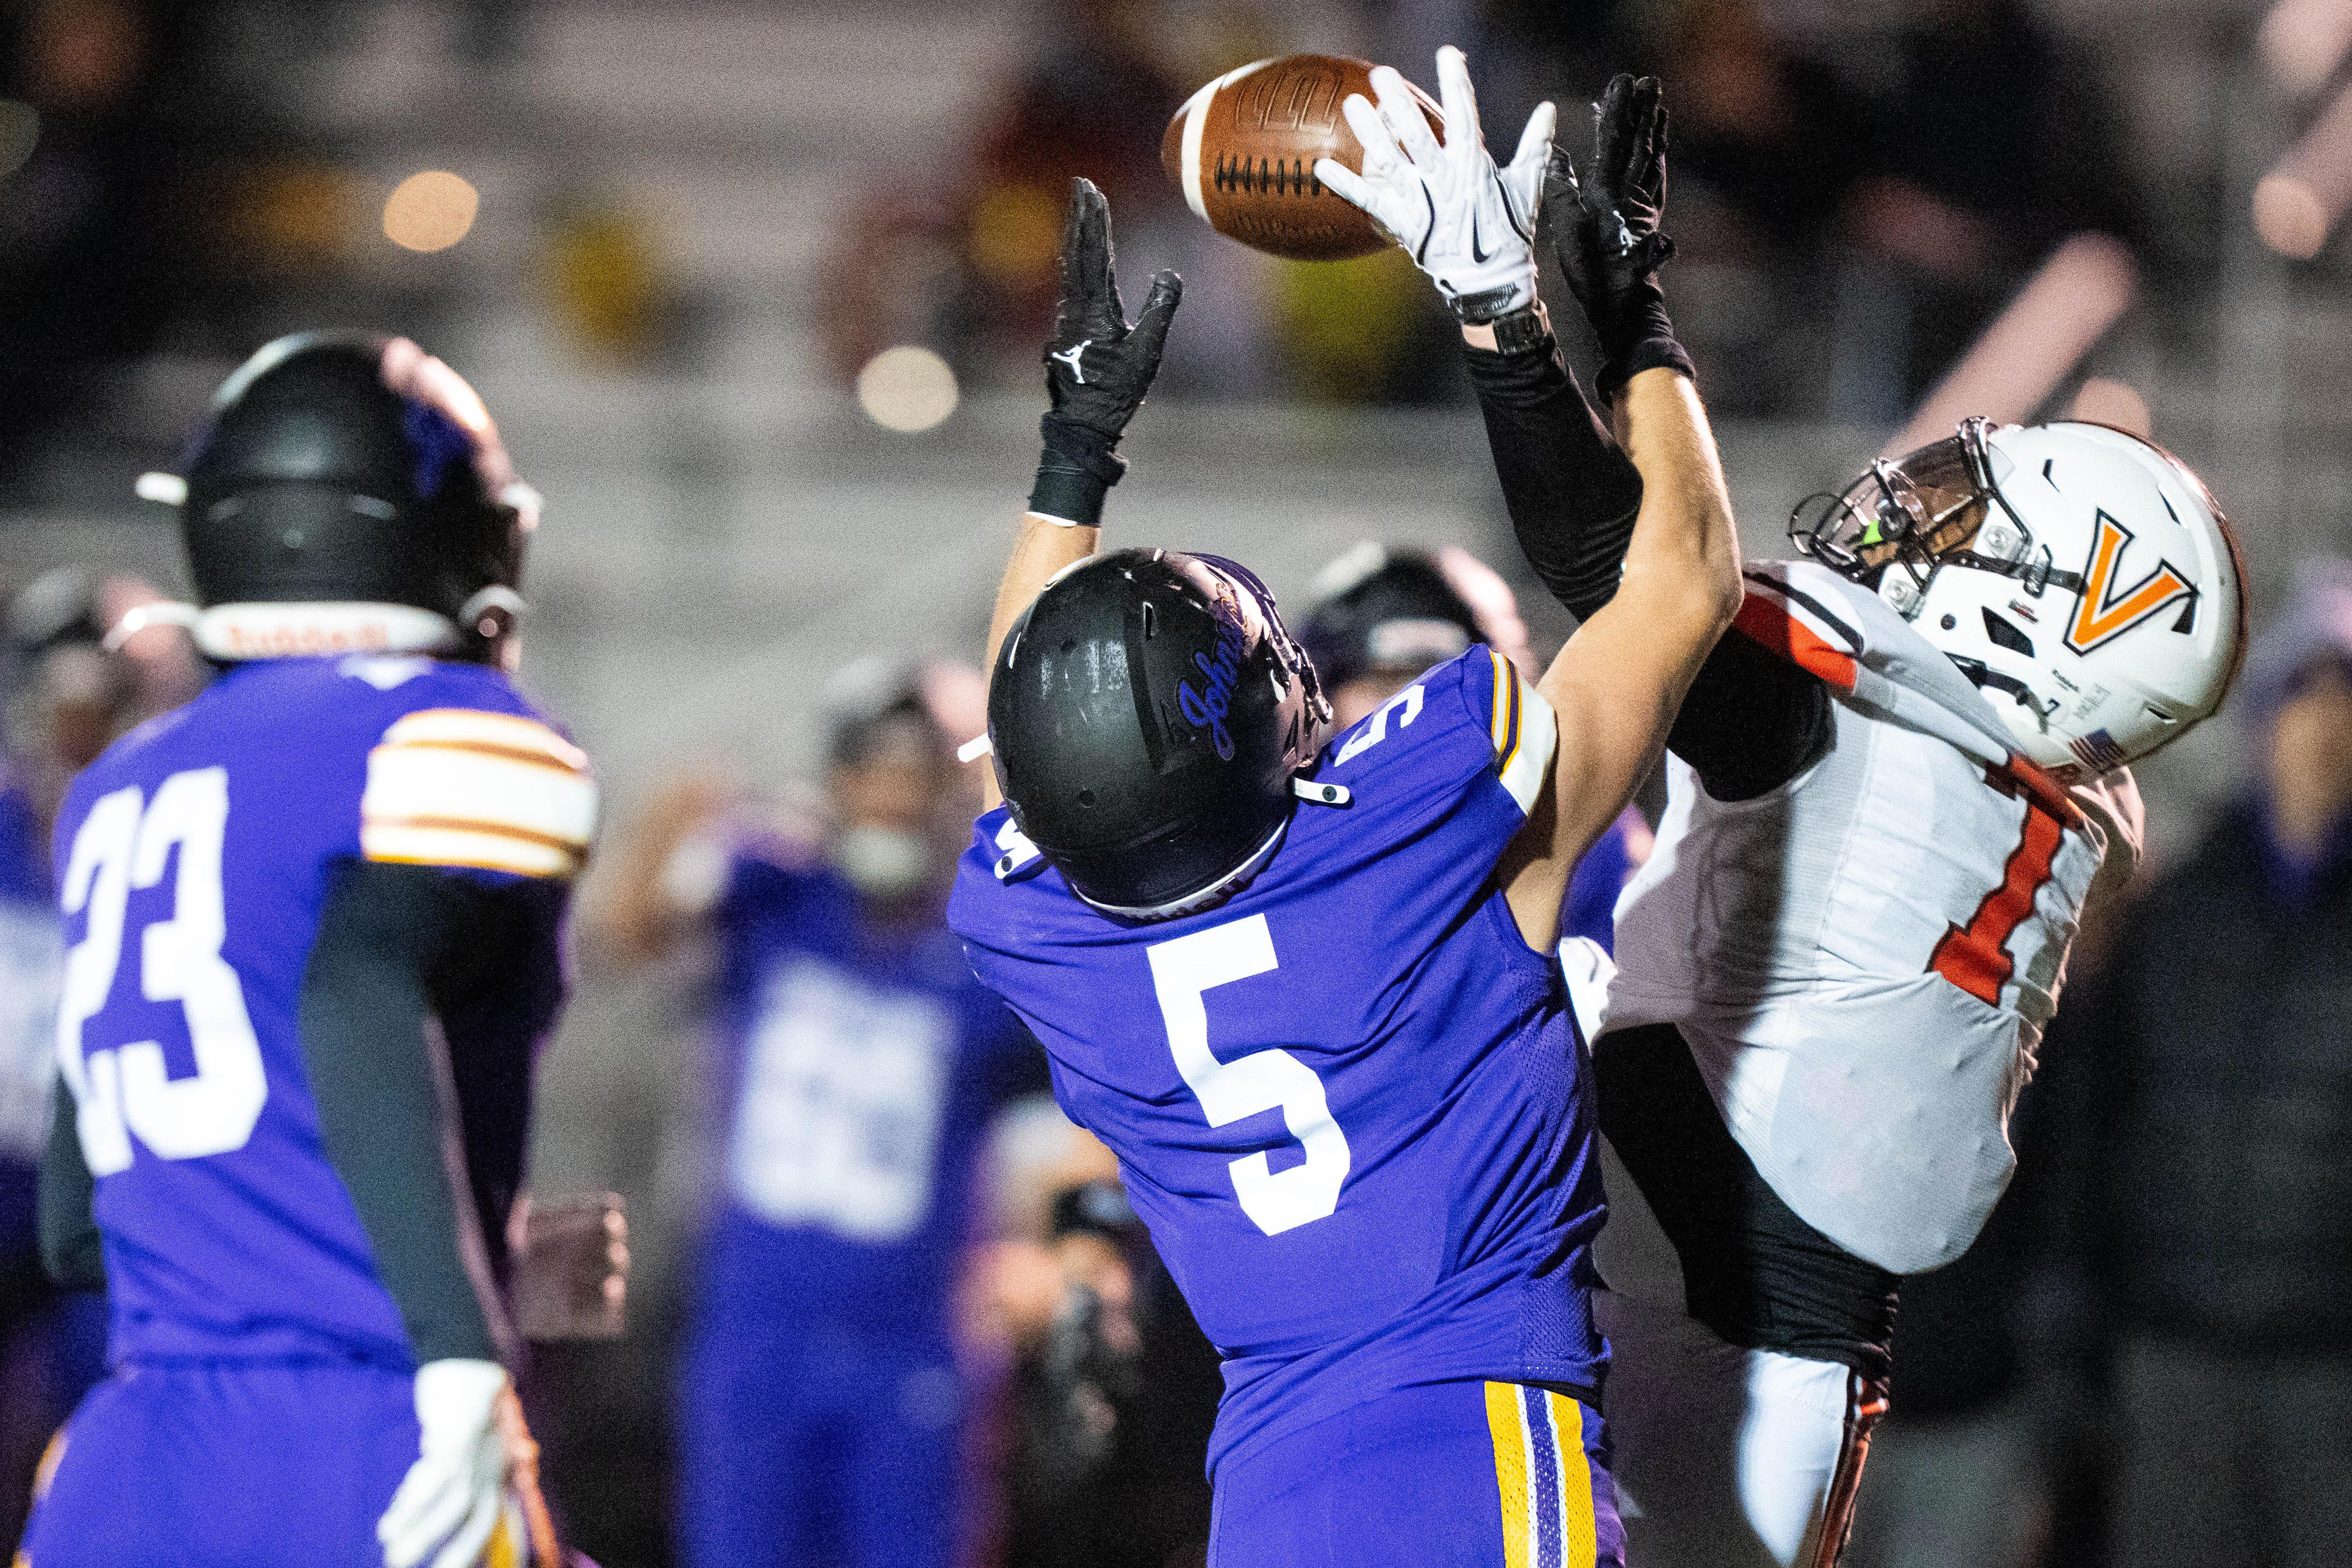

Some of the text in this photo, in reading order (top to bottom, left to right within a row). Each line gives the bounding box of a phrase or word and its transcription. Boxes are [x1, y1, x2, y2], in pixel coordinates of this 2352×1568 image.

[2062, 506, 2202, 657] V
[55, 766, 268, 1177] 23
[1146, 912, 1350, 1237] 5
